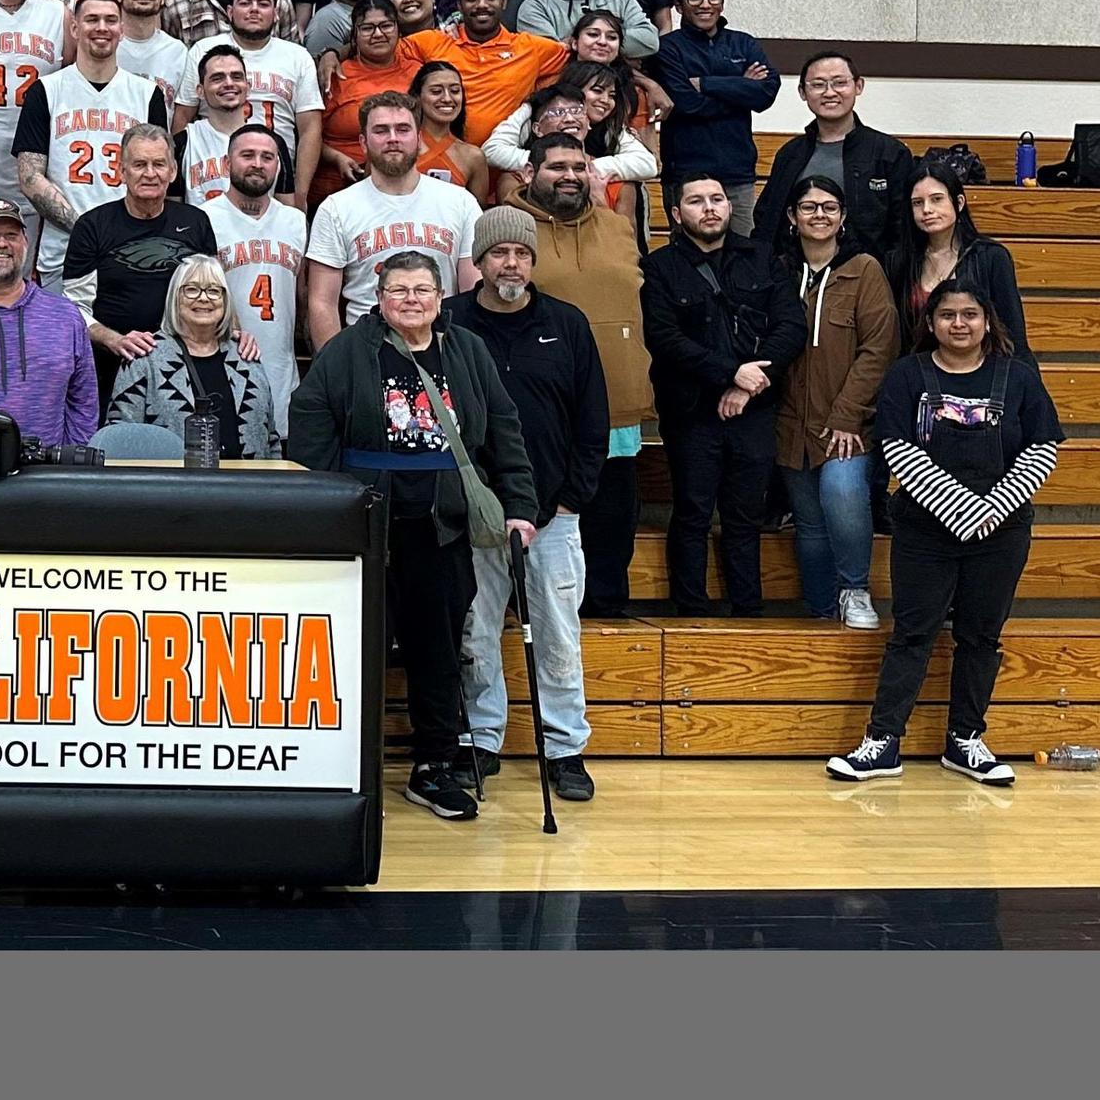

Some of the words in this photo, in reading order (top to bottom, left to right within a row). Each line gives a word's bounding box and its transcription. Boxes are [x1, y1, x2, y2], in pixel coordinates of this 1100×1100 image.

[68, 141, 123, 187] 23
[218, 240, 300, 272] EAGLES
[354, 223, 454, 261] EAGLES
[250, 274, 274, 320] 4
[131, 571, 168, 591] TO
[175, 572, 228, 593] THE
[59, 742, 127, 769] FOR
[137, 744, 202, 770] THE
[212, 745, 300, 771] DEAF
